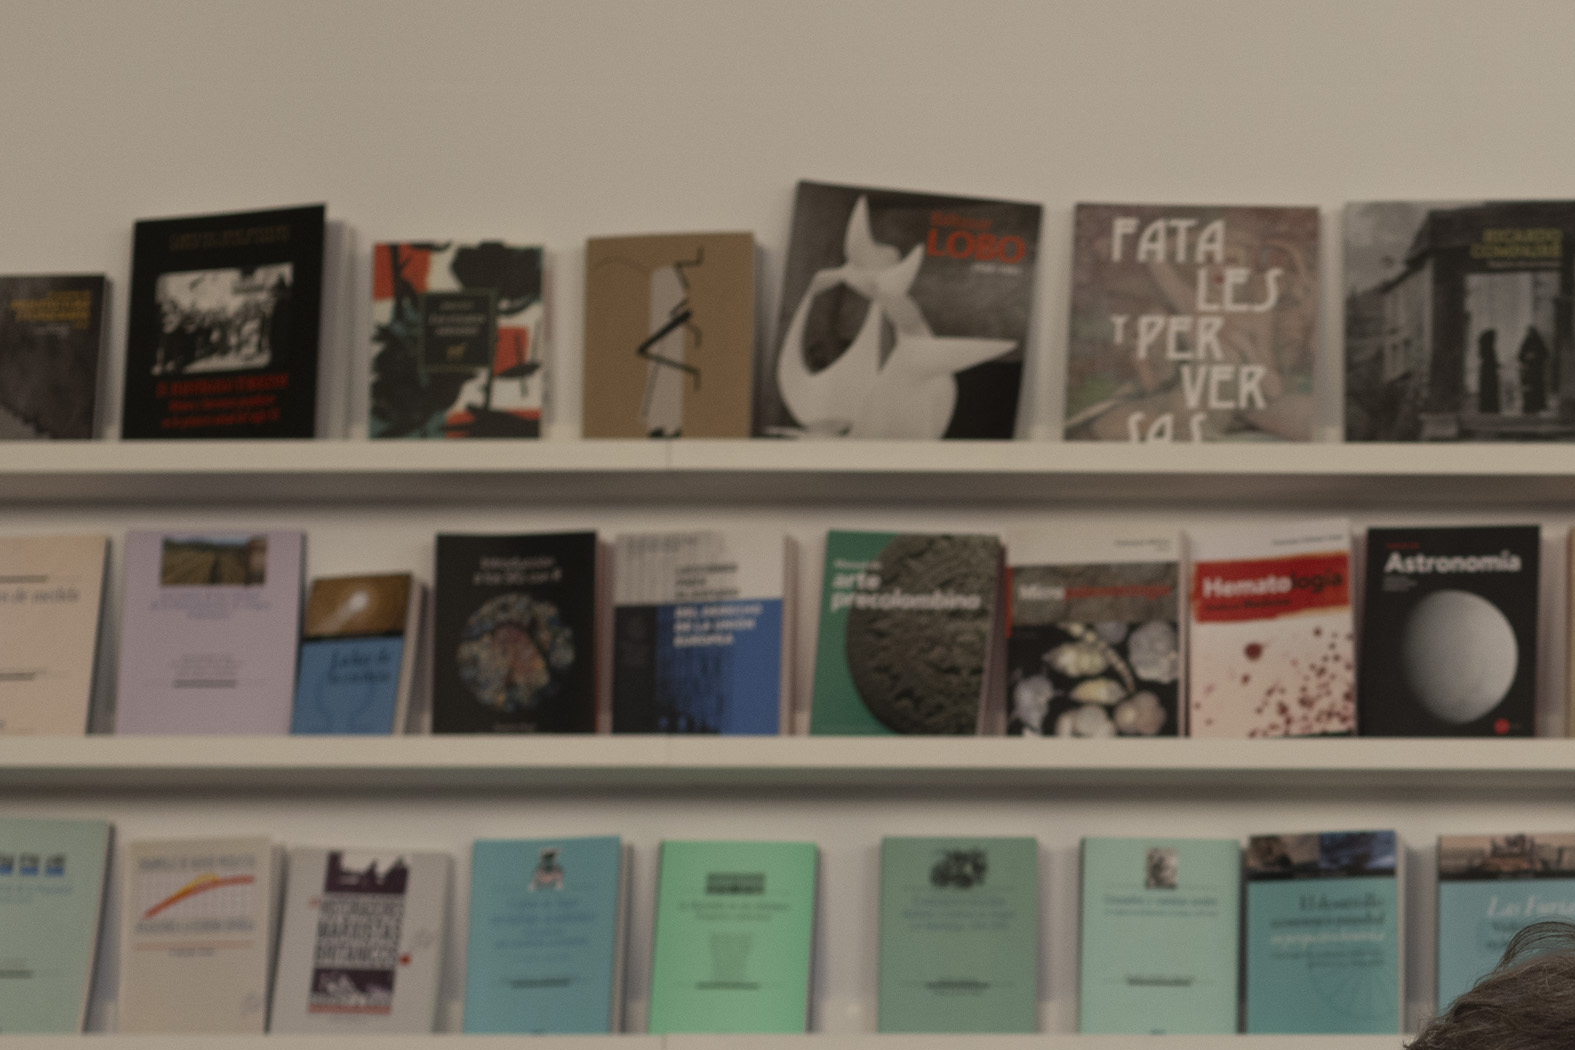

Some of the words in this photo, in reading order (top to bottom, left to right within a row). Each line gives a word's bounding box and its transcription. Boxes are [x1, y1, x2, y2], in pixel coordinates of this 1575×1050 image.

[927, 230, 1026, 264] LOBO
[1112, 217, 1226, 262] FATA
[1196, 269, 1284, 313] LES
[1136, 315, 1225, 361] PER
[1179, 366, 1266, 410] VER
[1384, 548, 1523, 574] Astronomía
[831, 573, 882, 590] arte
[1201, 569, 1343, 600] Hematología
[829, 588, 982, 614] precolombino
